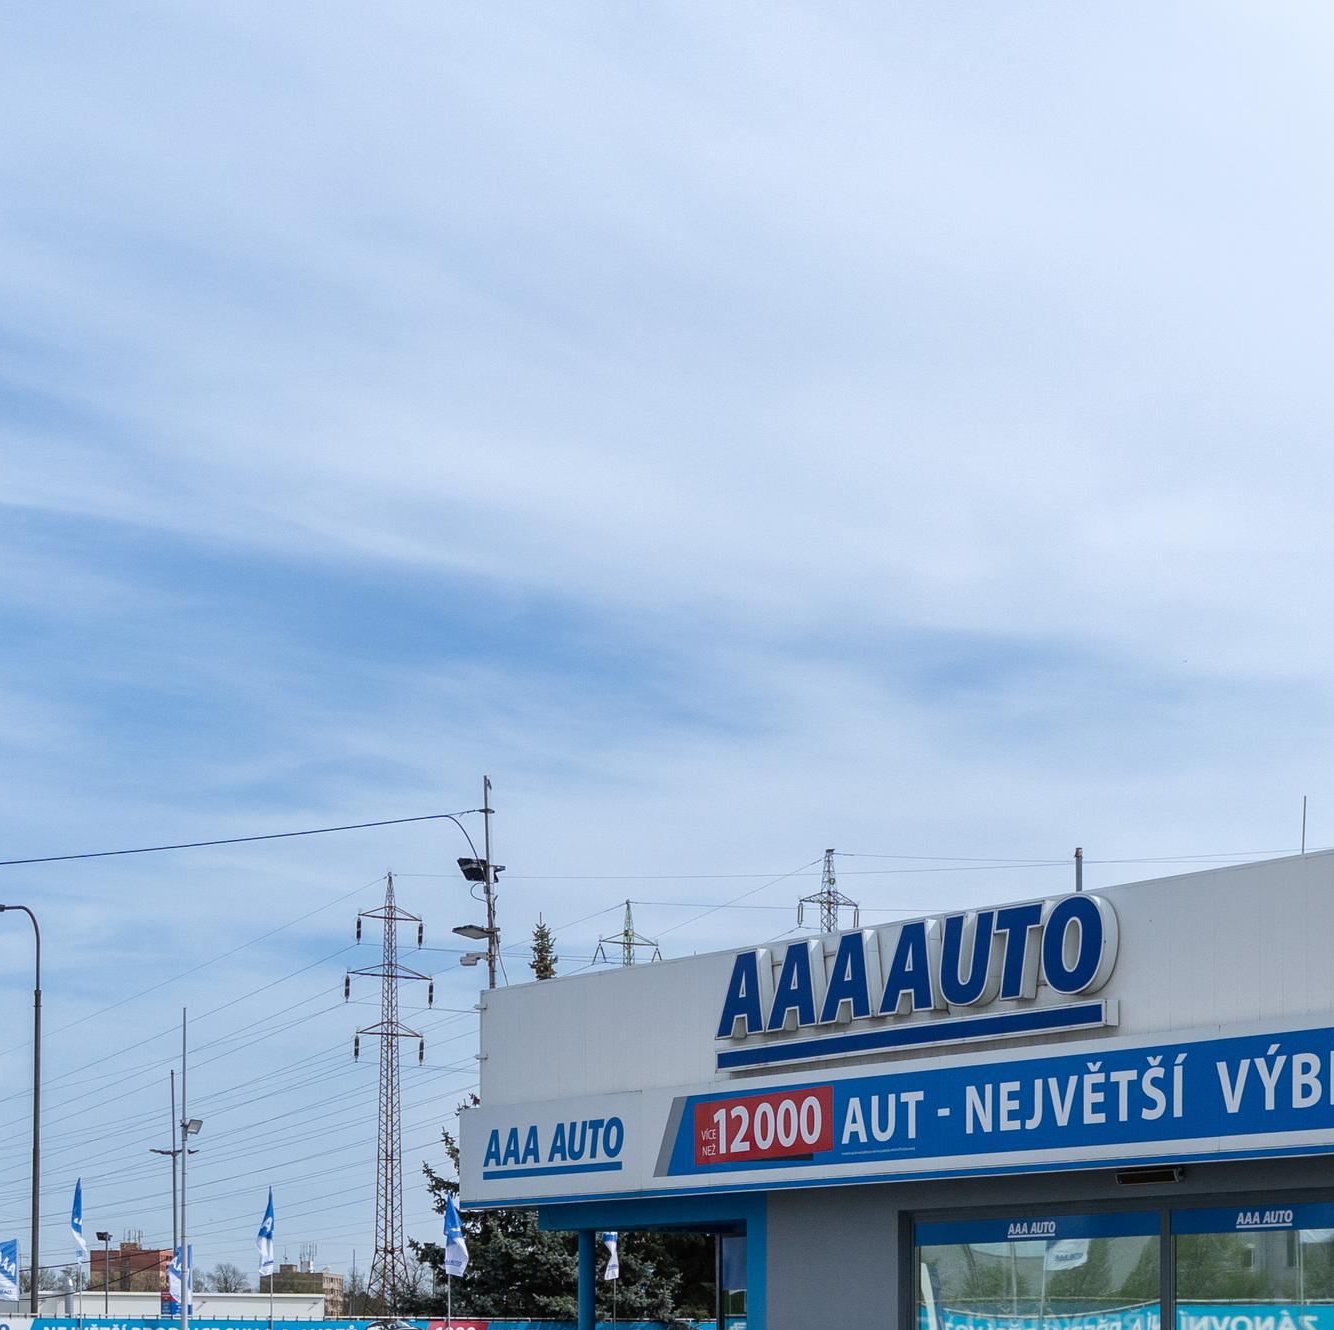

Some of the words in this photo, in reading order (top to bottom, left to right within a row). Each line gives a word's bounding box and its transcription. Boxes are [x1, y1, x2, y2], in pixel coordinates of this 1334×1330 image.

[842, 1090, 924, 1144] AUT
[966, 1052, 1187, 1136] NEJVĚTŠÍ
[713, 1096, 822, 1155] 12000
[701, 1127, 717, 1140] VÍCE
[483, 1124, 540, 1168] AAA
[548, 1116, 624, 1162] AUTO
[702, 1144, 716, 1157] NEŽ
[1236, 1212, 1261, 1225] AAA
[1263, 1210, 1292, 1224] AUTO
[1008, 1223, 1028, 1235] AAA
[1030, 1221, 1055, 1234] AUTO
